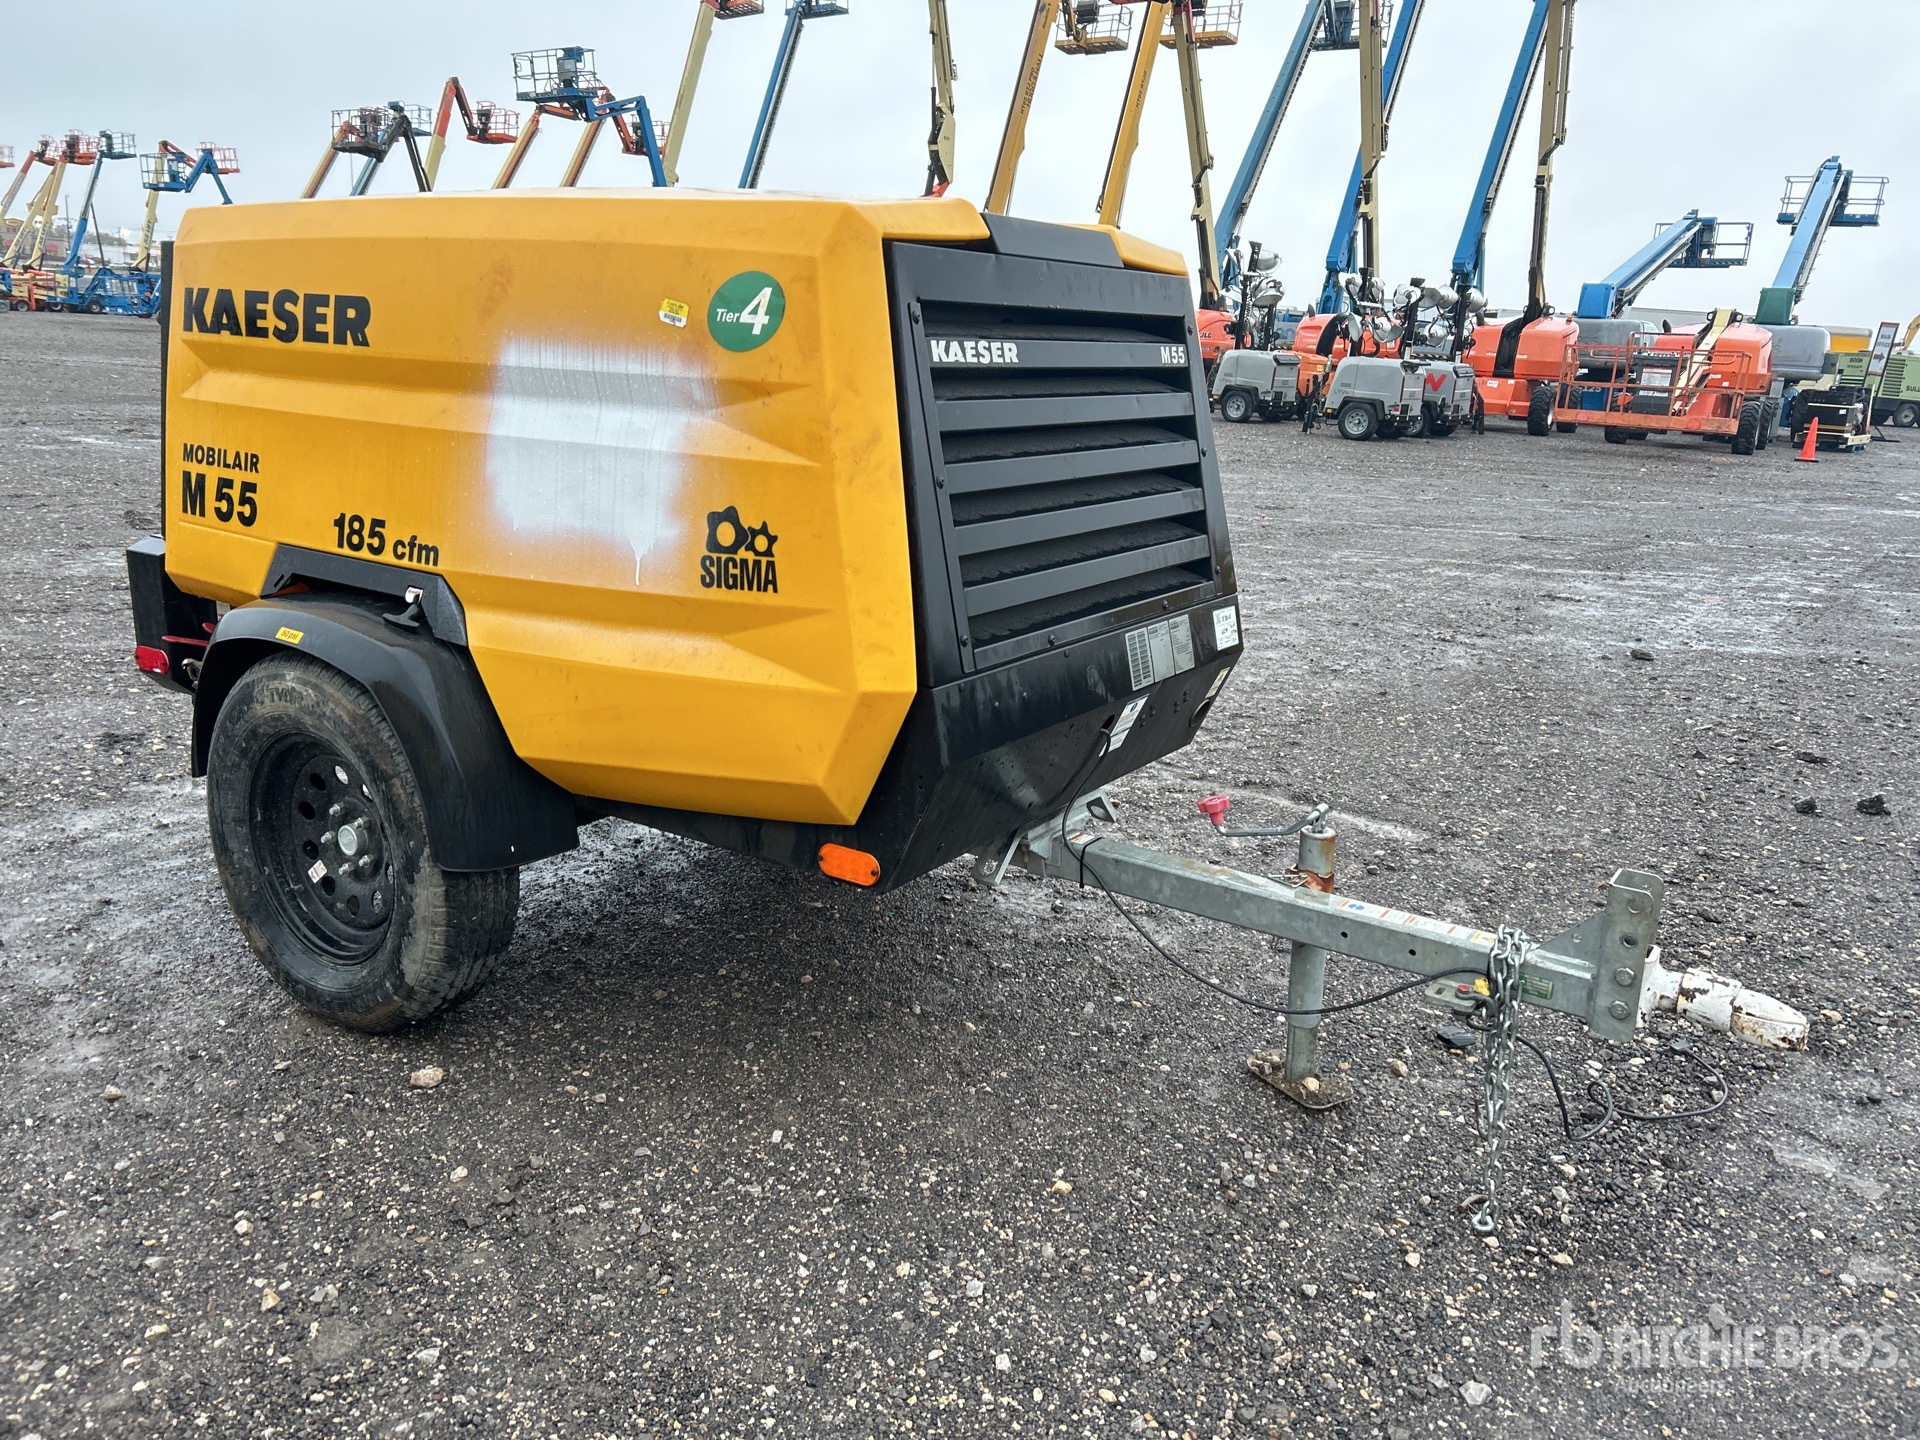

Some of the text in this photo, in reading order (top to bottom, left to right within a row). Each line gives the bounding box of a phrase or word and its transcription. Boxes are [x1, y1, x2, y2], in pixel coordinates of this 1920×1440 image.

[183, 287, 371, 347] KAESER
[716, 308, 740, 322] Tier
[739, 286, 773, 335] 4
[930, 339, 1019, 364] KAESER
[182, 442, 260, 474] MOBILAIR
[181, 470, 258, 527] M 55
[332, 512, 440, 567] 185 cfm
[700, 554, 779, 594] SIGMA
